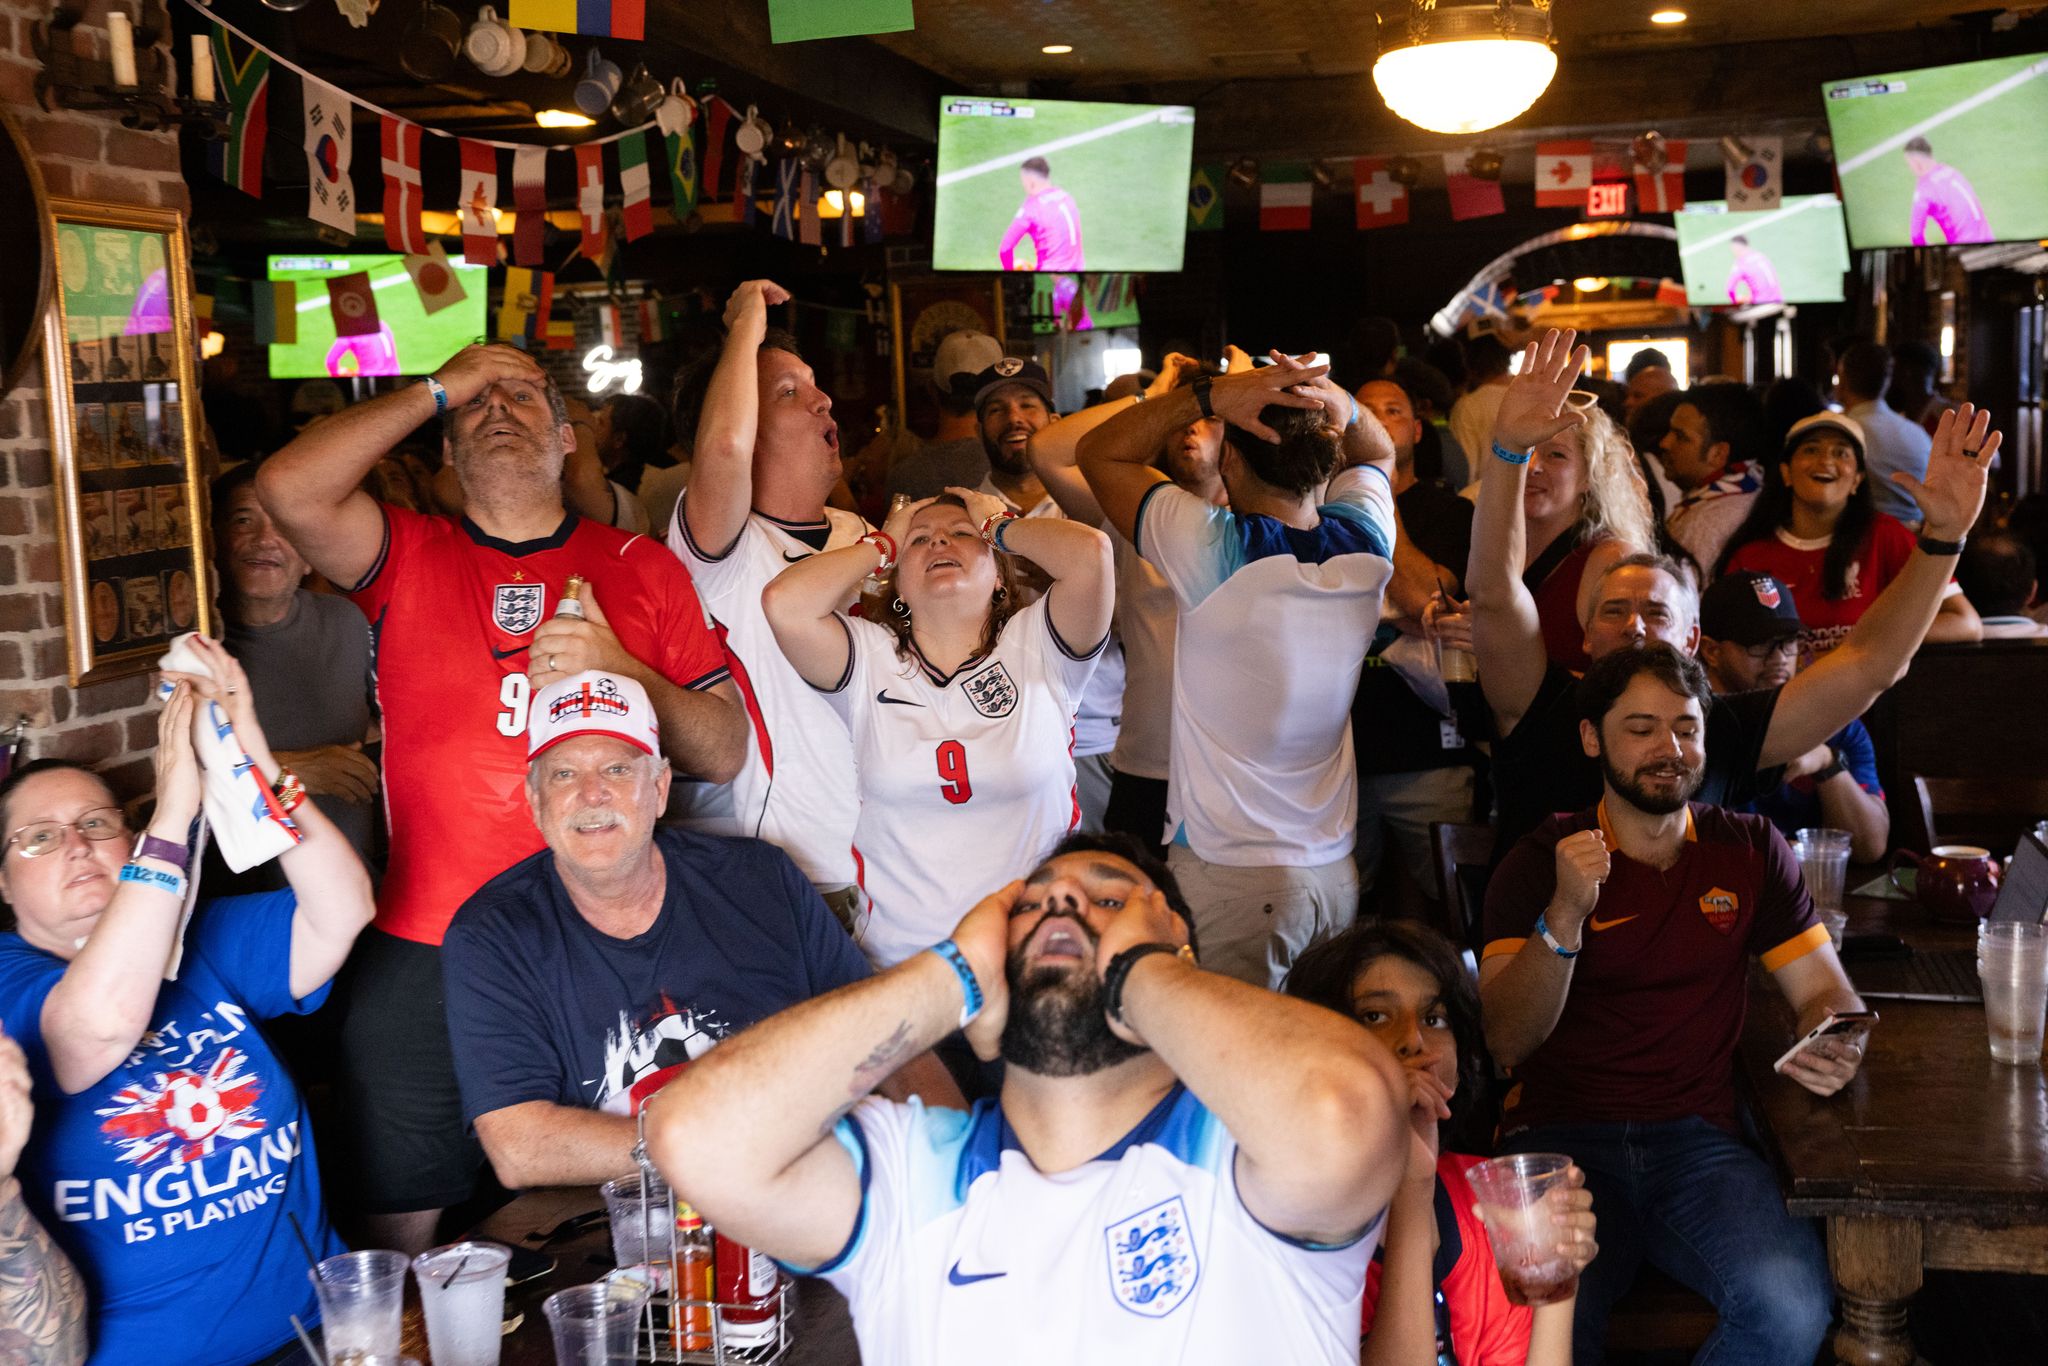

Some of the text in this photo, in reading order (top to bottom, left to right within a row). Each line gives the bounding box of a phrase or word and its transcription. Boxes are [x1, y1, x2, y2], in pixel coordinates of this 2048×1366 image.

[1587, 184, 1627, 216] EXIT
[496, 672, 531, 737] 9
[549, 690, 629, 723] ENGLAND
[936, 739, 973, 804] 9
[123, 1173, 288, 1244] IS PLAYING
